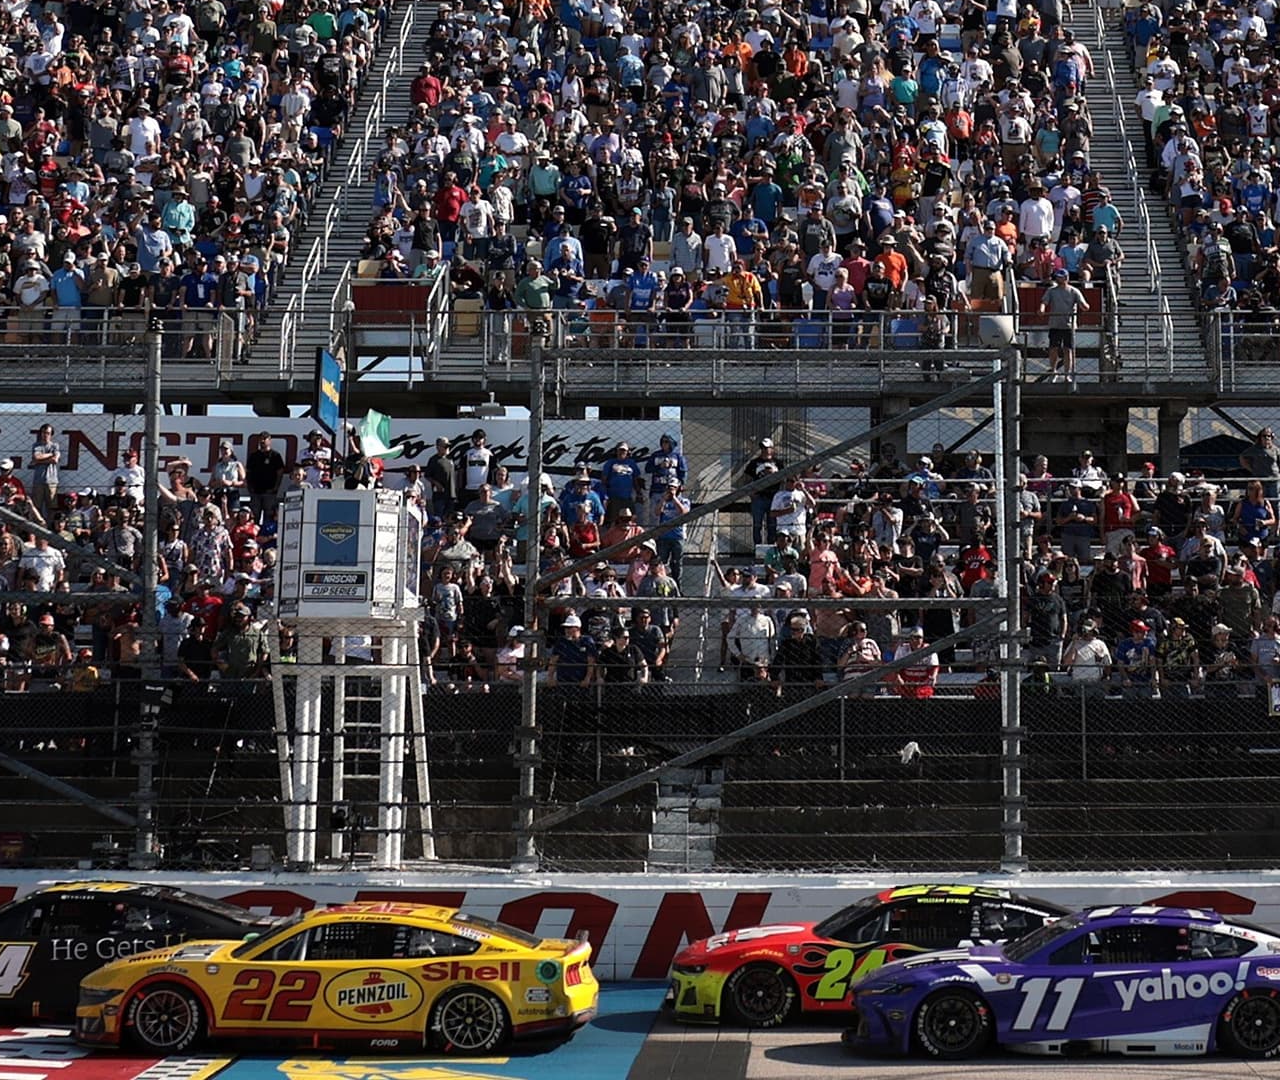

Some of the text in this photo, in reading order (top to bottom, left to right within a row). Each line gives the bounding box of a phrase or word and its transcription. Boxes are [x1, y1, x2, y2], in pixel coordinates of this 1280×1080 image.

[311, 586, 358, 596] CUP SERIES
[323, 575, 358, 584] NASCAR
[51, 938, 88, 961] He
[96, 937, 156, 960] Gets
[421, 961, 521, 982] Shell
[815, 949, 889, 1000] 24
[224, 969, 322, 1022] 22
[337, 982, 409, 1007] PENNZOIL
[1113, 961, 1252, 1011] yahoo!
[1012, 977, 1086, 1031] 11
[370, 1038, 399, 1048] FORD
